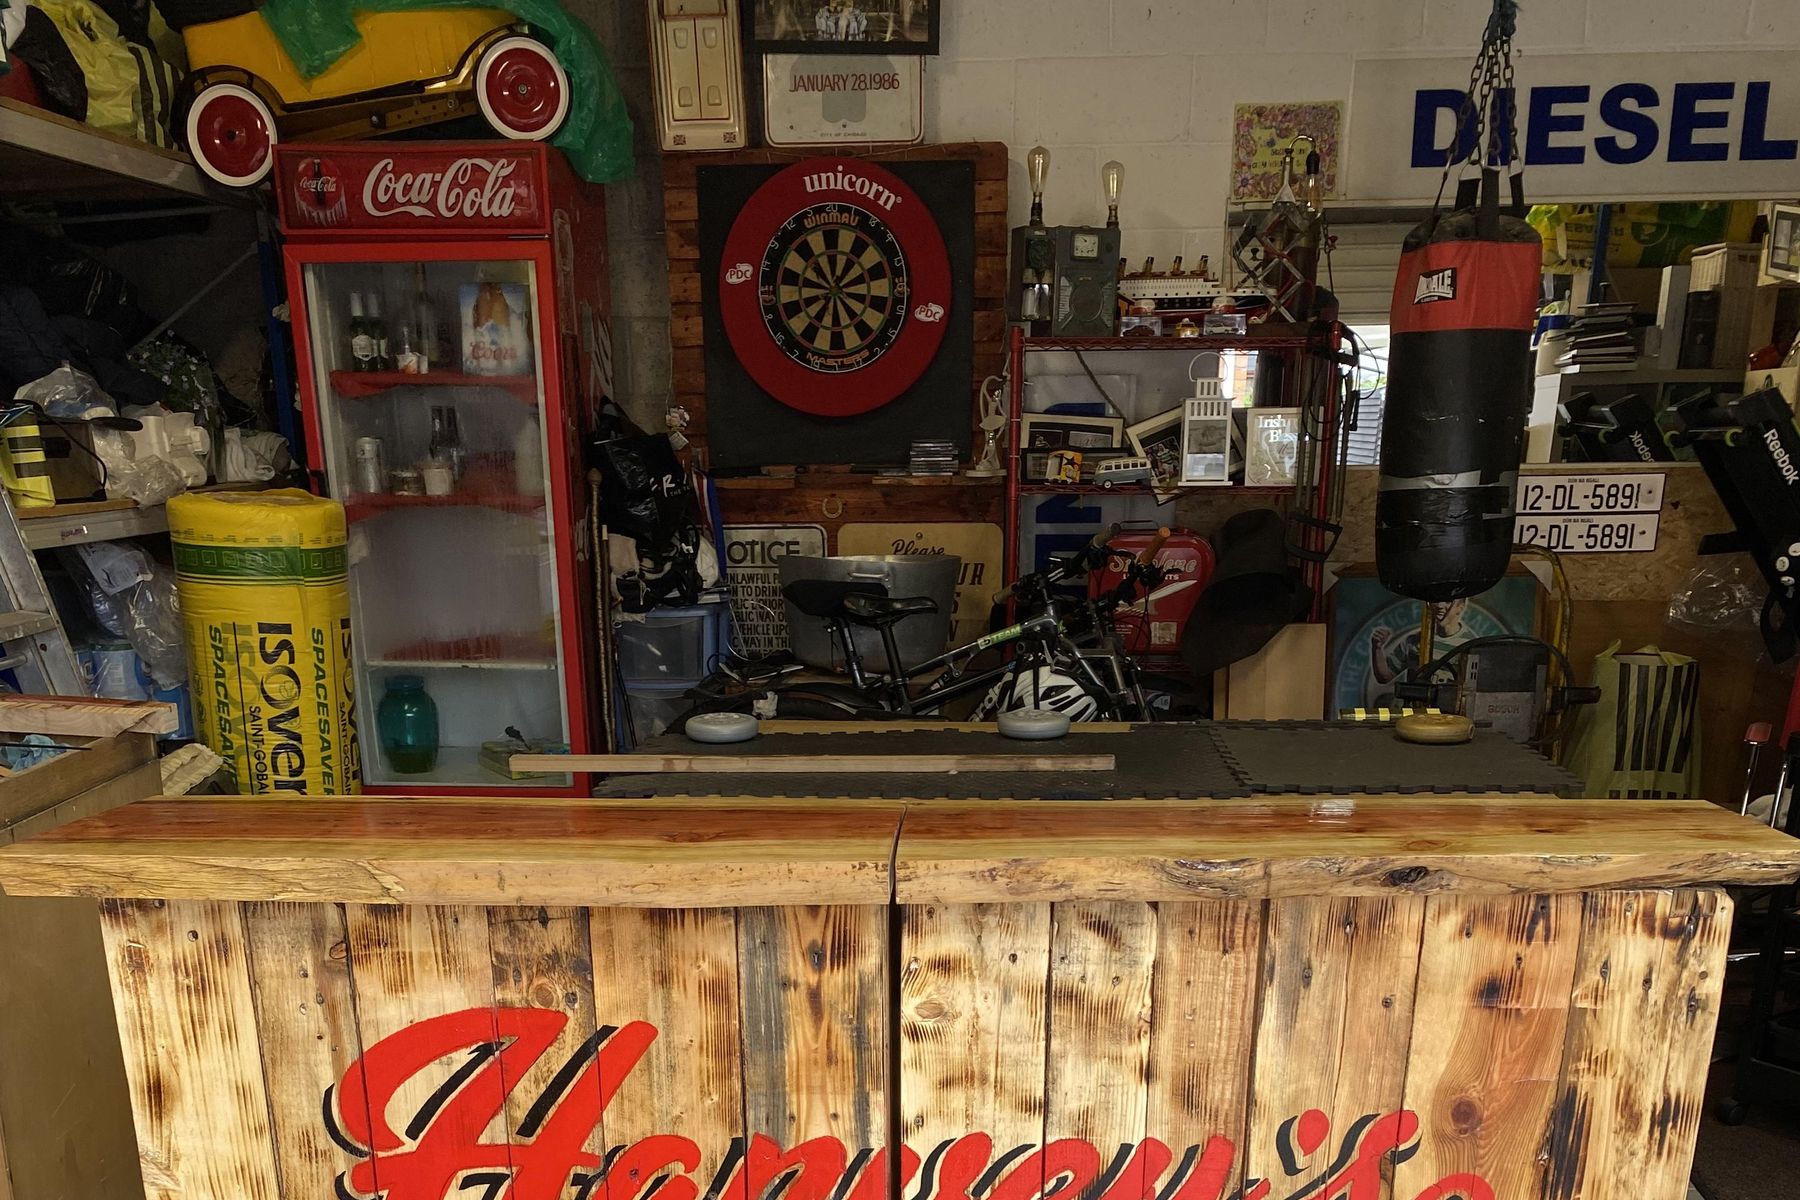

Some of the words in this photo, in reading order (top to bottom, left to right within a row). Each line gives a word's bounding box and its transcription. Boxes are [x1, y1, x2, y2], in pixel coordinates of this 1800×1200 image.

[789, 74, 849, 92] JANUARY
[1411, 81, 1799, 168] DIESEL
[362, 158, 517, 218] Coca-Cola
[803, 165, 898, 211] unicorn
[729, 270, 751, 281] PDC
[918, 306, 940, 321] PDC
[1258, 415, 1286, 428] Irish
[1628, 430, 1655, 462] ebok
[1763, 428, 1800, 486] Reebok
[1523, 483, 1641, 511] 12-DL-5891
[1519, 523, 1635, 549] 12-DL-5891
[727, 540, 800, 565] OTICE
[892, 539, 945, 556] Please
[726, 573, 771, 585] NLAWFUL
[741, 585, 753, 597] TO
[731, 611, 754, 622] BLIC
[738, 624, 772, 635] VEHICLE
[743, 637, 762, 648] WAY
[763, 637, 773, 648] IN
[249, 705, 271, 795] SAINT-GOBAI
